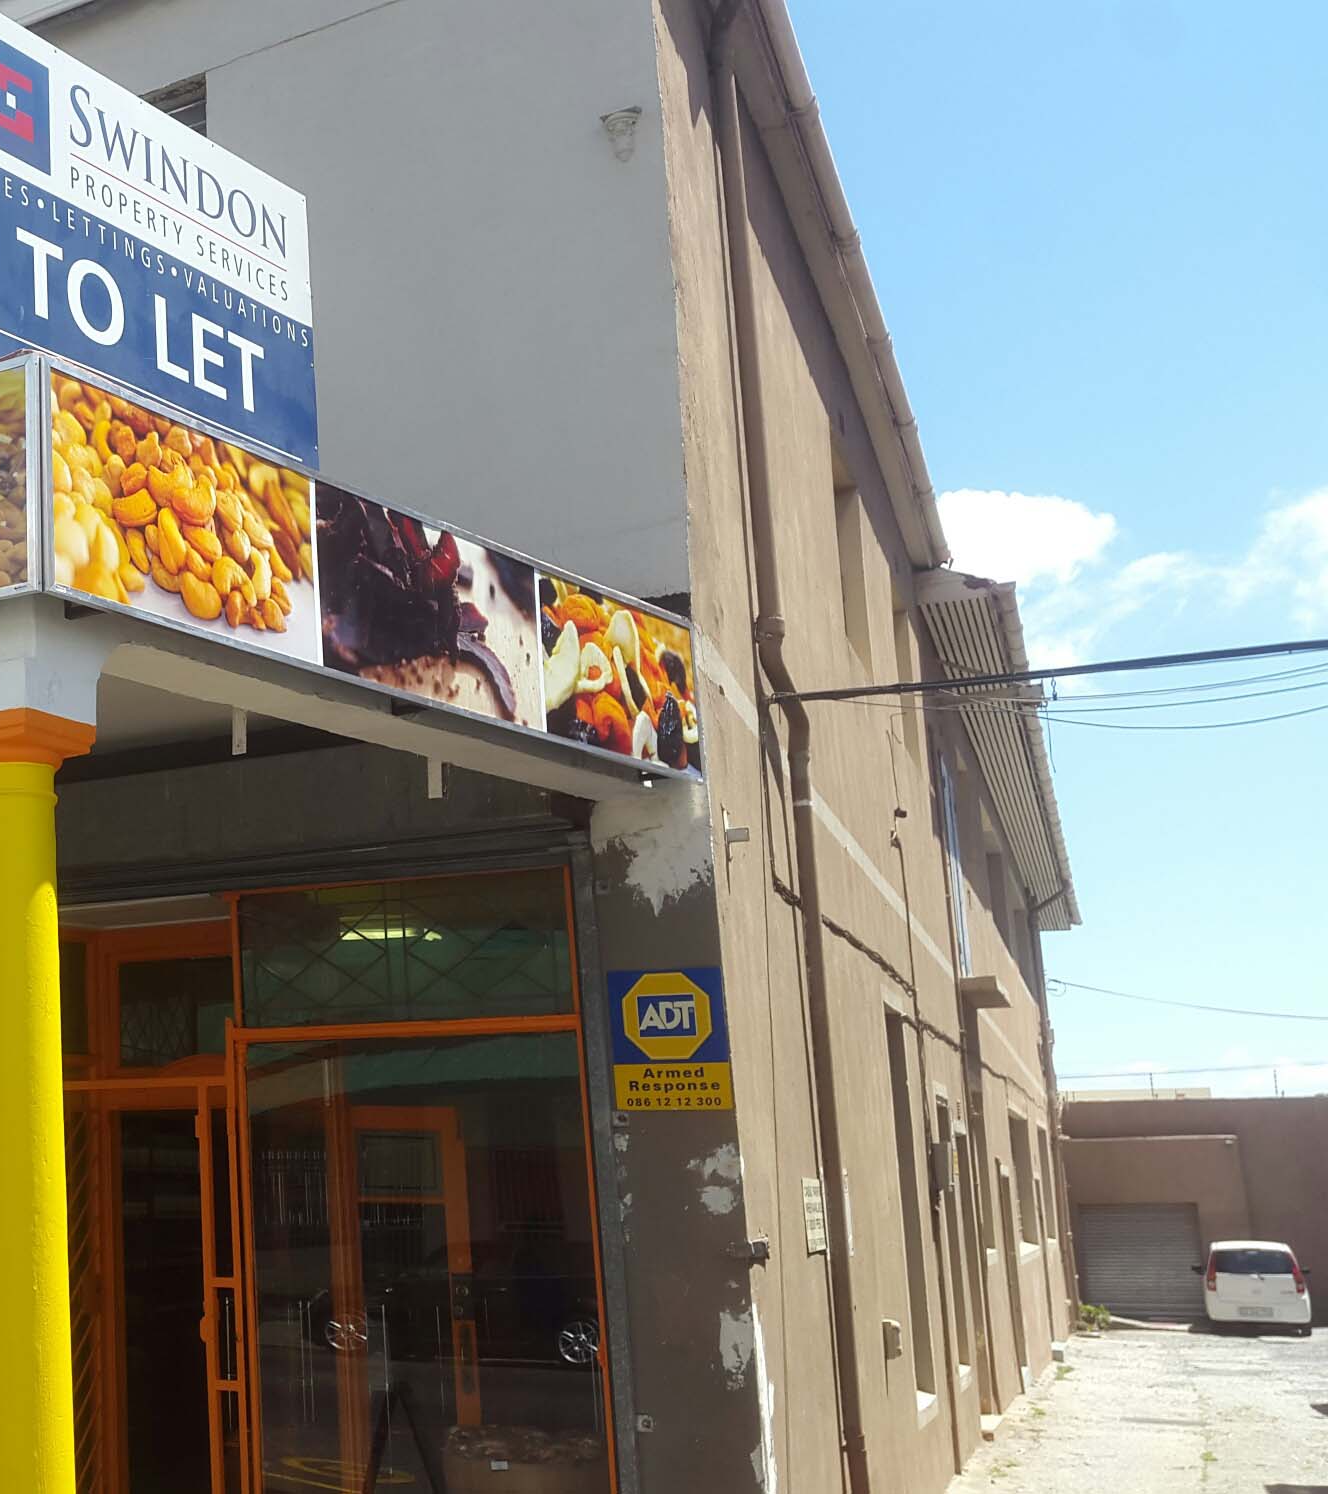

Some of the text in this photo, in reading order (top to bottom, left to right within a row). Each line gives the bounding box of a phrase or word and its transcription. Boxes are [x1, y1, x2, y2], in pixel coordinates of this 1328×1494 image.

[69, 84, 287, 259] SWINDON
[52, 200, 165, 275] LETTINGS
[184, 271, 309, 347] VALUATIONS
[70, 166, 288, 302] PROPERTY SERVICES
[16, 227, 265, 413] TO LET
[639, 1000, 695, 1031] ADT
[626, 1096, 722, 1107] 086 12 12 300
[629, 1080, 720, 1093] Response
[642, 1066, 705, 1079] Armed
